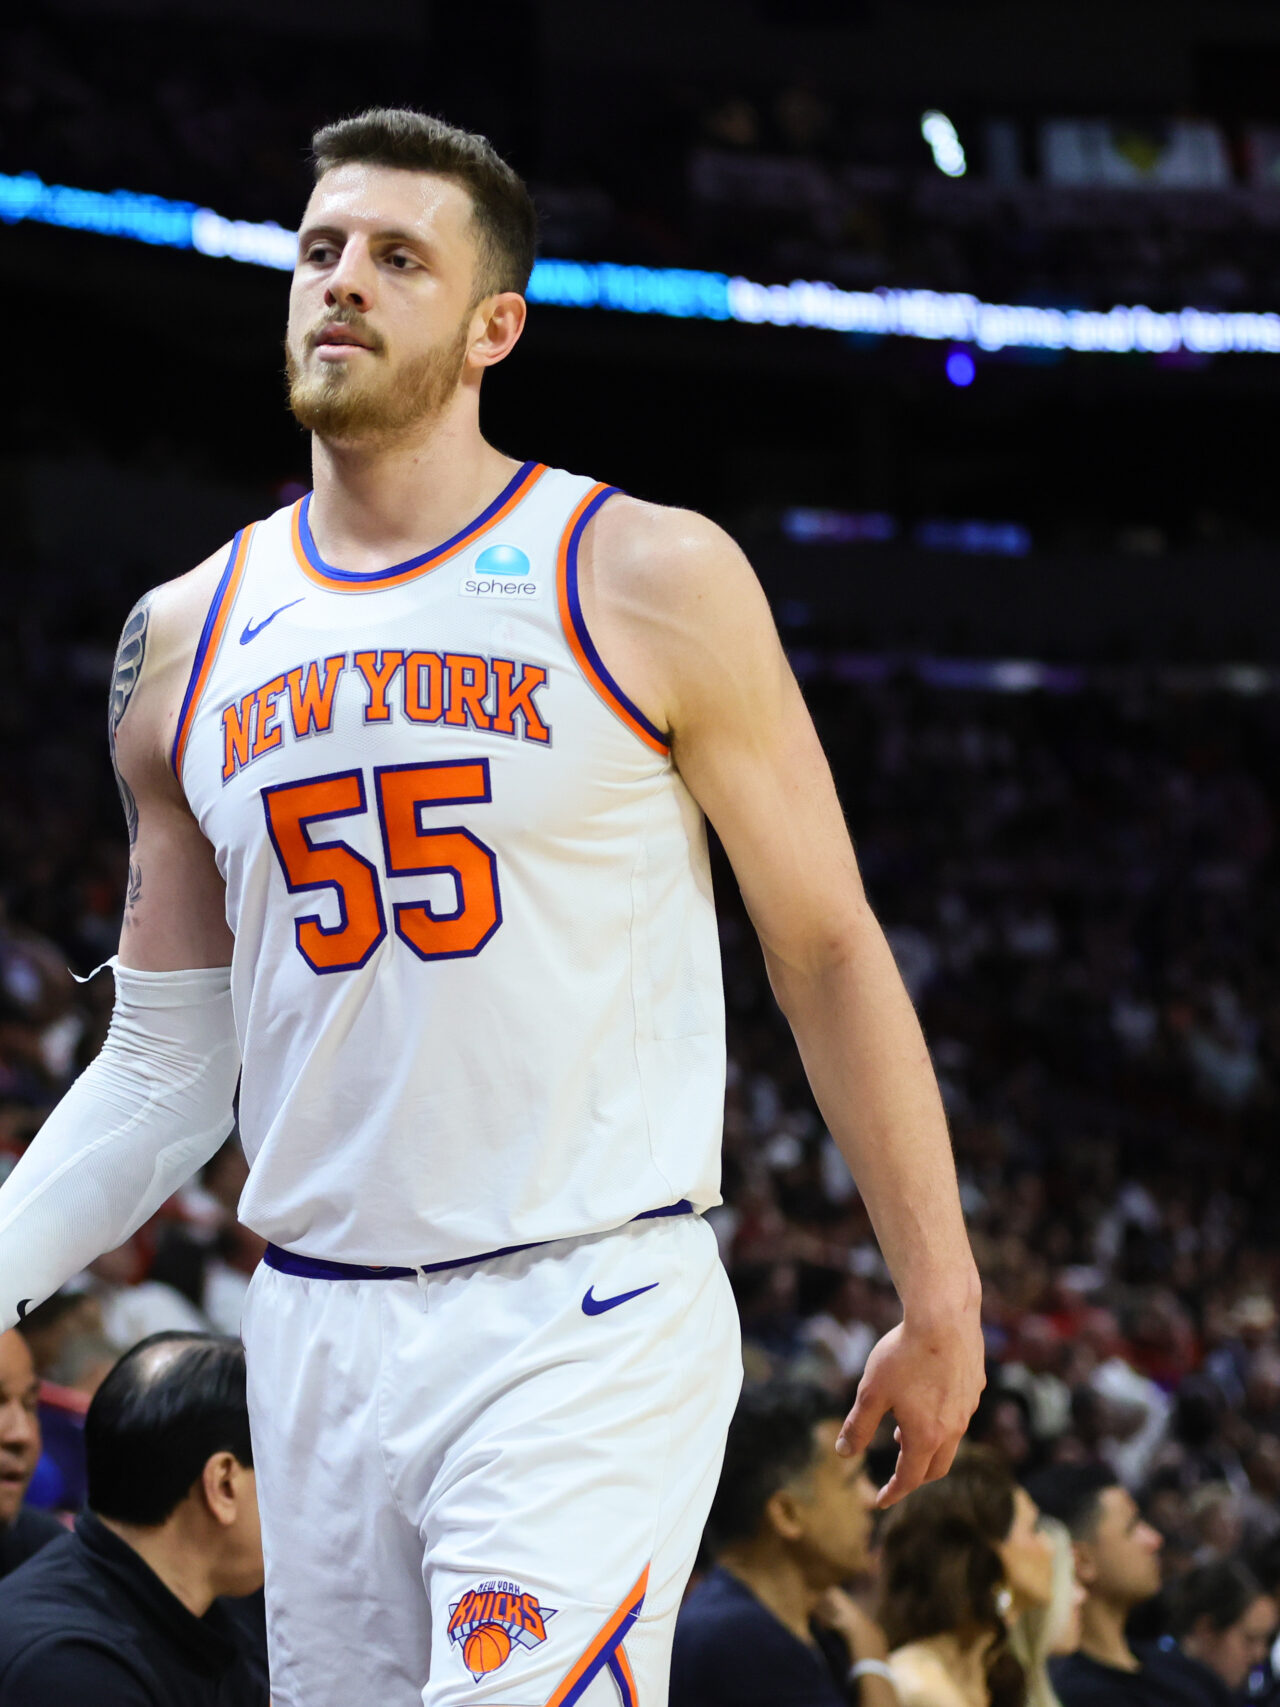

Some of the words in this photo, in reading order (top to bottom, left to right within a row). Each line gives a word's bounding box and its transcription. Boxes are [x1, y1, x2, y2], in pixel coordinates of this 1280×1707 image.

[465, 579, 536, 596] sphere
[221, 651, 347, 785] NEW
[354, 648, 552, 748] YORK
[260, 757, 503, 975] 55
[477, 1580, 497, 1593] NEW
[497, 1581, 520, 1595] YORK
[447, 1589, 548, 1642] KNICKS
